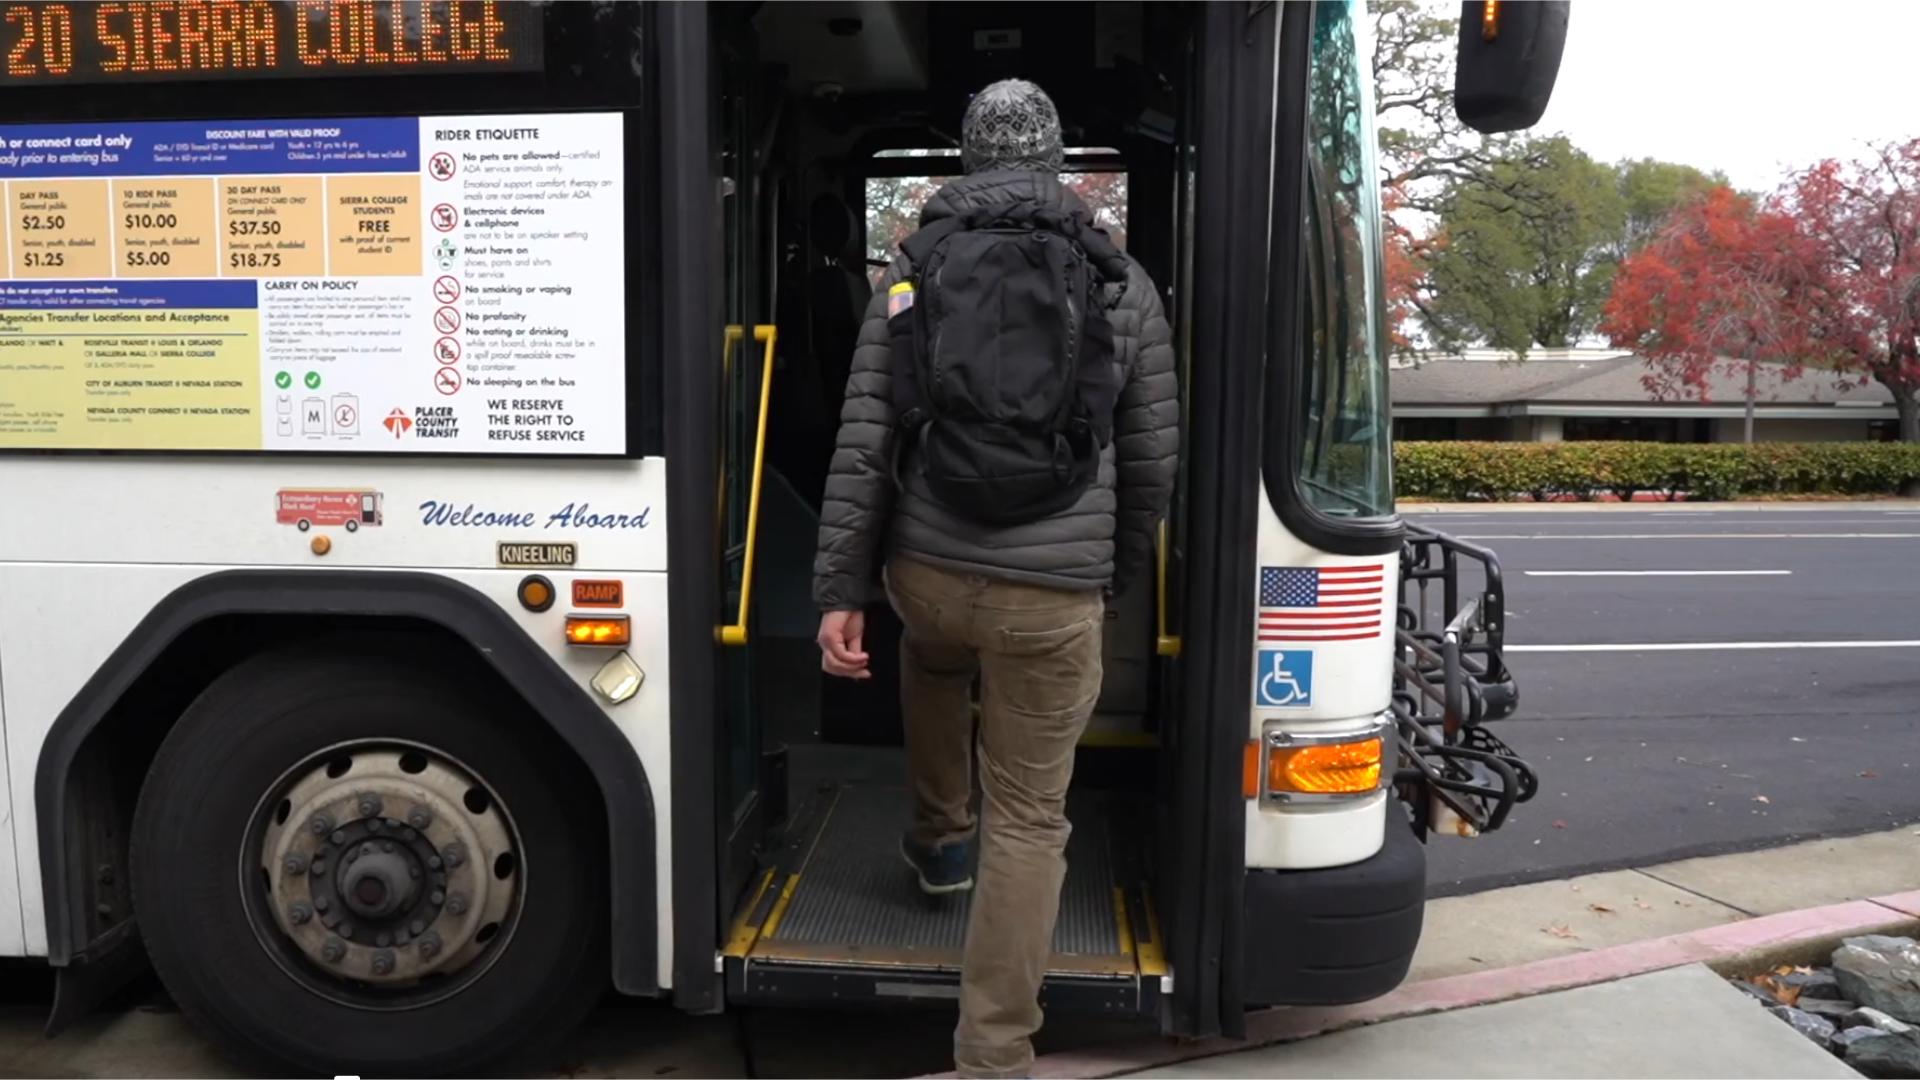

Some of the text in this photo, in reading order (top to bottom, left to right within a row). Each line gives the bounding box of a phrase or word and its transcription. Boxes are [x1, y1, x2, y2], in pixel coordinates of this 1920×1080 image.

[6, 0, 510, 75] 20 SIERRA COLLEGE
[435, 128, 540, 141] RIDER ETIQUETTE
[9, 139, 23, 148] or
[26, 137, 71, 148] connect
[75, 134, 101, 147] card
[105, 134, 133, 149] only
[21, 152, 44, 167] prior
[47, 152, 55, 163] to
[60, 152, 98, 166] entering
[101, 150, 119, 162] bus
[353, 207, 395, 215] STUDENTS
[464, 207, 545, 216] Electronic devices
[22, 215, 65, 230] $2.50
[125, 214, 177, 229] $10.00
[359, 220, 390, 232] FREE
[474, 219, 519, 229] cellphone
[229, 220, 281, 236] $37.50
[464, 247, 487, 255] Must
[24, 252, 64, 267] $1.25
[127, 251, 170, 266] $5.00
[231, 253, 281, 267] $18.75
[264, 281, 359, 290] CARRY ON POLICY
[482, 285, 523, 295] smoking
[539, 285, 572, 295] vaping
[47, 313, 89, 322] Transfer
[93, 313, 141, 322] Locations
[145, 312, 166, 322] and
[170, 312, 230, 324] Acceptance
[482, 312, 526, 322] profanity
[483, 327, 512, 337] eating
[529, 327, 568, 337] drinking
[484, 378, 522, 388] sleeping
[558, 378, 575, 386] bus
[487, 399, 564, 410] WE RESERVE
[415, 407, 453, 417] PLACER
[415, 417, 458, 427] COUNTY
[488, 414, 574, 426] THE RIGHT TO
[416, 428, 460, 438] TRANSIT
[488, 430, 585, 441] REFUSE SERVICE
[419, 500, 651, 530] Welcome Aboard
[502, 545, 573, 564] KNEELING
[575, 584, 618, 601] RAMP
